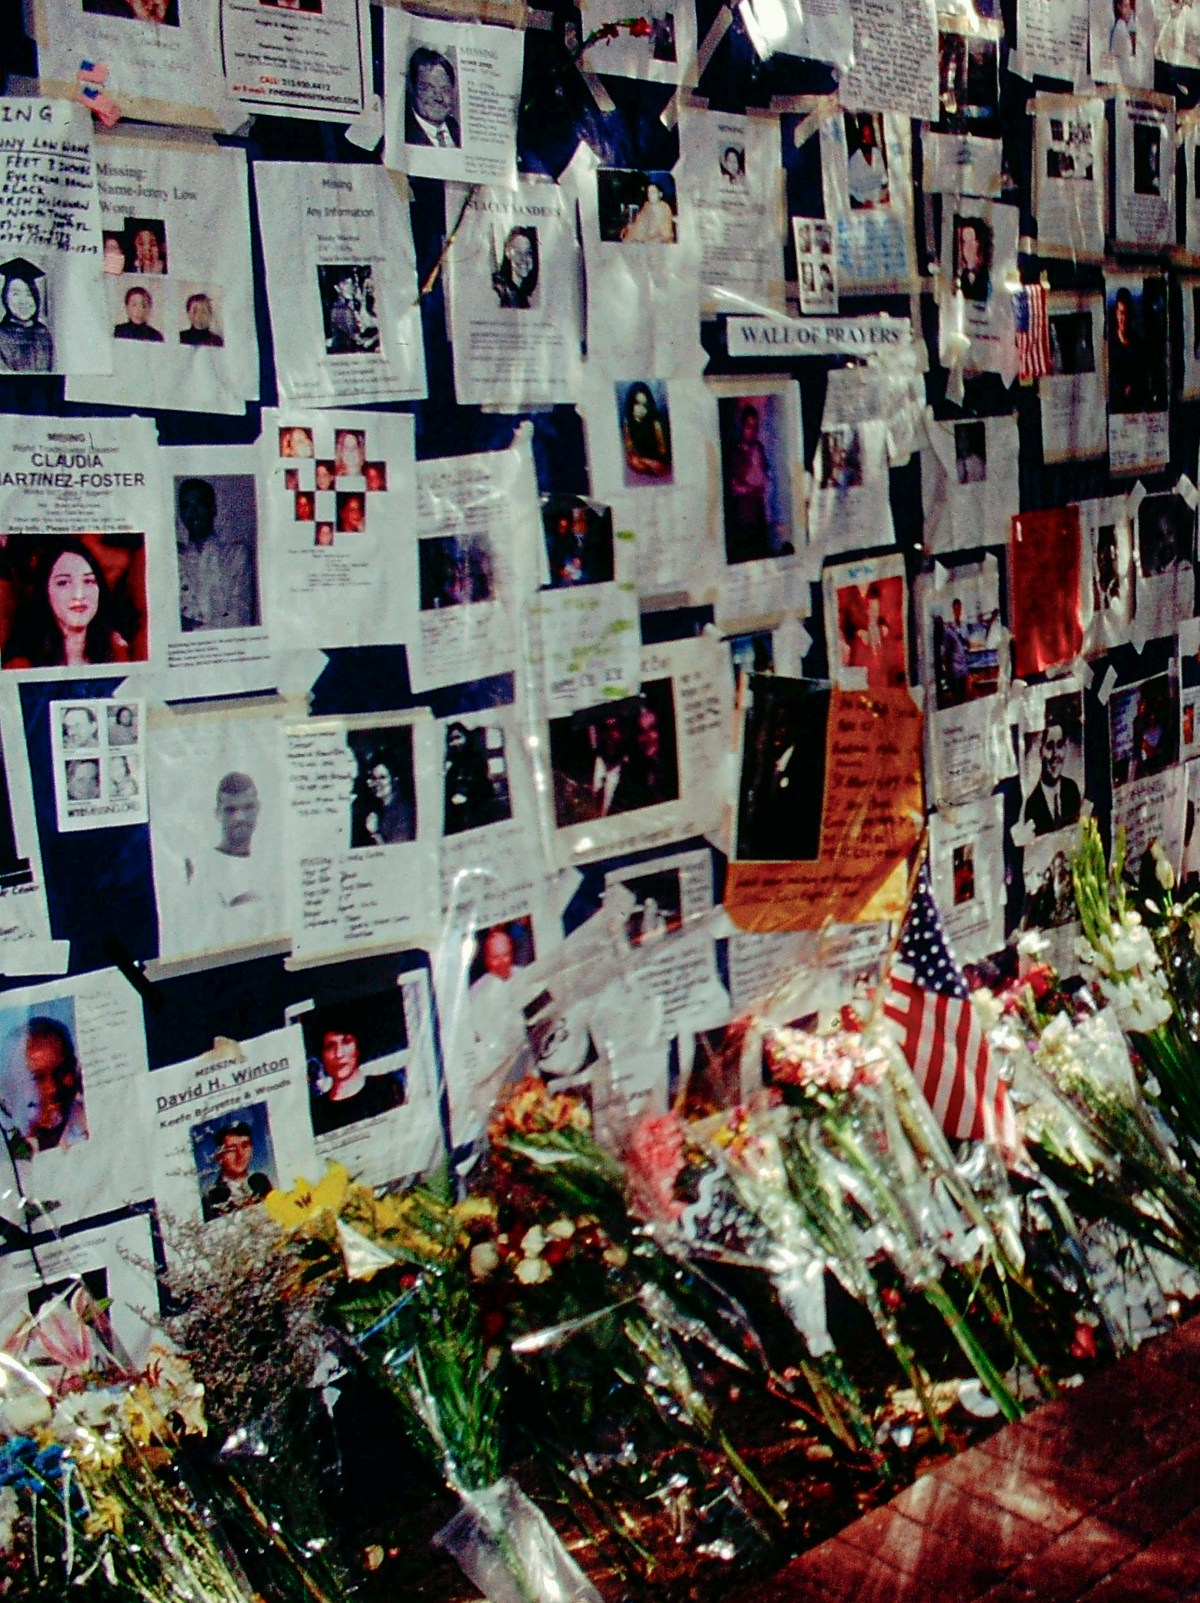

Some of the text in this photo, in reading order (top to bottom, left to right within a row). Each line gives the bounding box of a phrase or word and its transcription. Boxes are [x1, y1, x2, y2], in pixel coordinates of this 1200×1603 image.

[741, 326, 900, 344] WALL OF PRAYERS
[31, 453, 104, 469] CLAUDIA
[0, 472, 146, 488] ARTINEZ-FOSTER
[157, 1057, 290, 1110] David H. Winton
